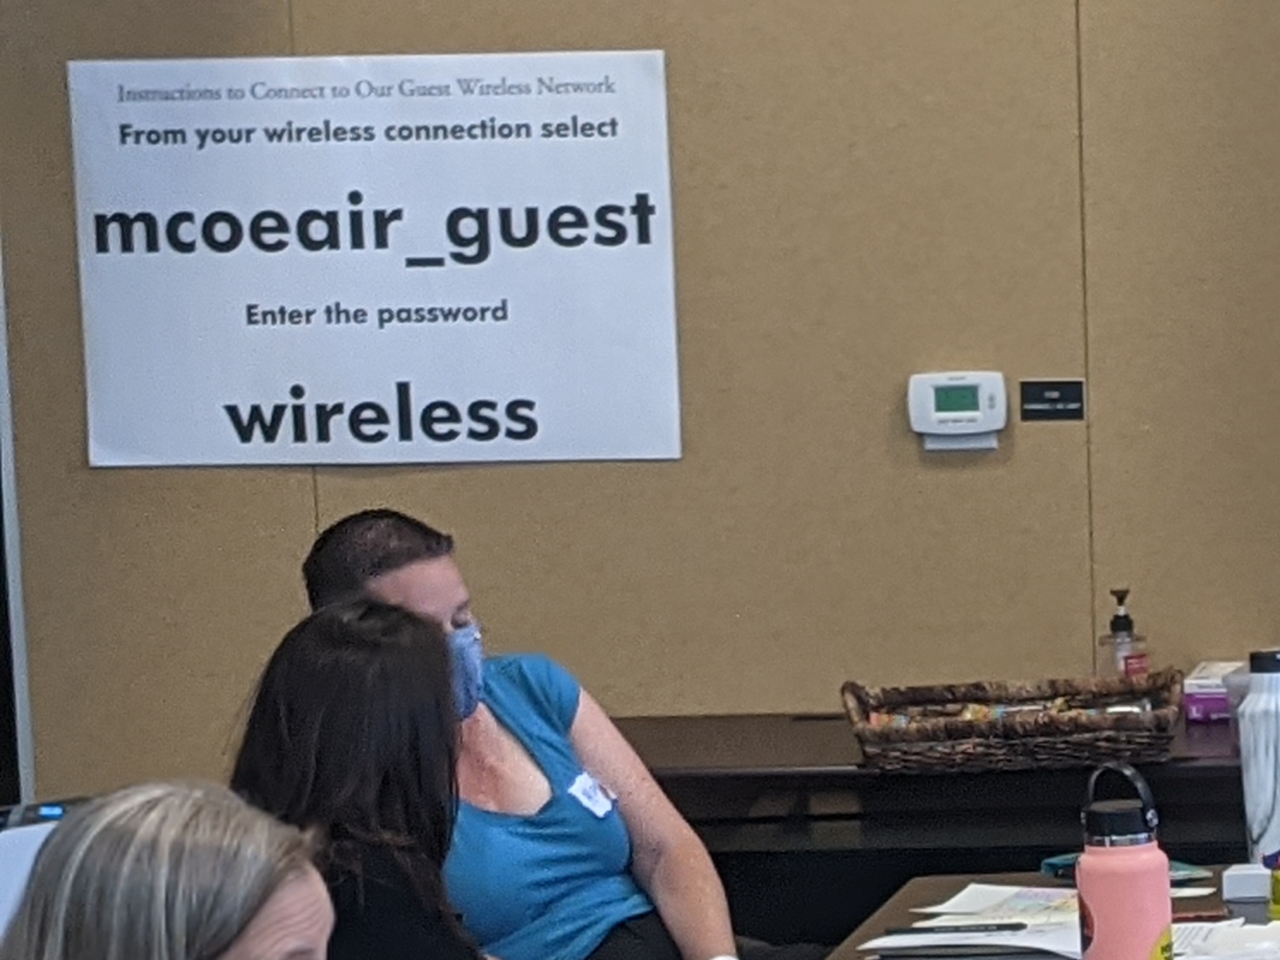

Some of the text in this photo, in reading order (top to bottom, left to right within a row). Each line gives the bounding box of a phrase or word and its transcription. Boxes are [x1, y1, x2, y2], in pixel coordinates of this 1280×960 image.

[117, 75, 616, 103] Instructions to Connect to Our Guest Wireless Network
[119, 115, 618, 150] From your wireless connection select
[94, 190, 656, 268] mcoeair_guest
[246, 299, 508, 329] Enter the password
[223, 381, 538, 444] wireless
